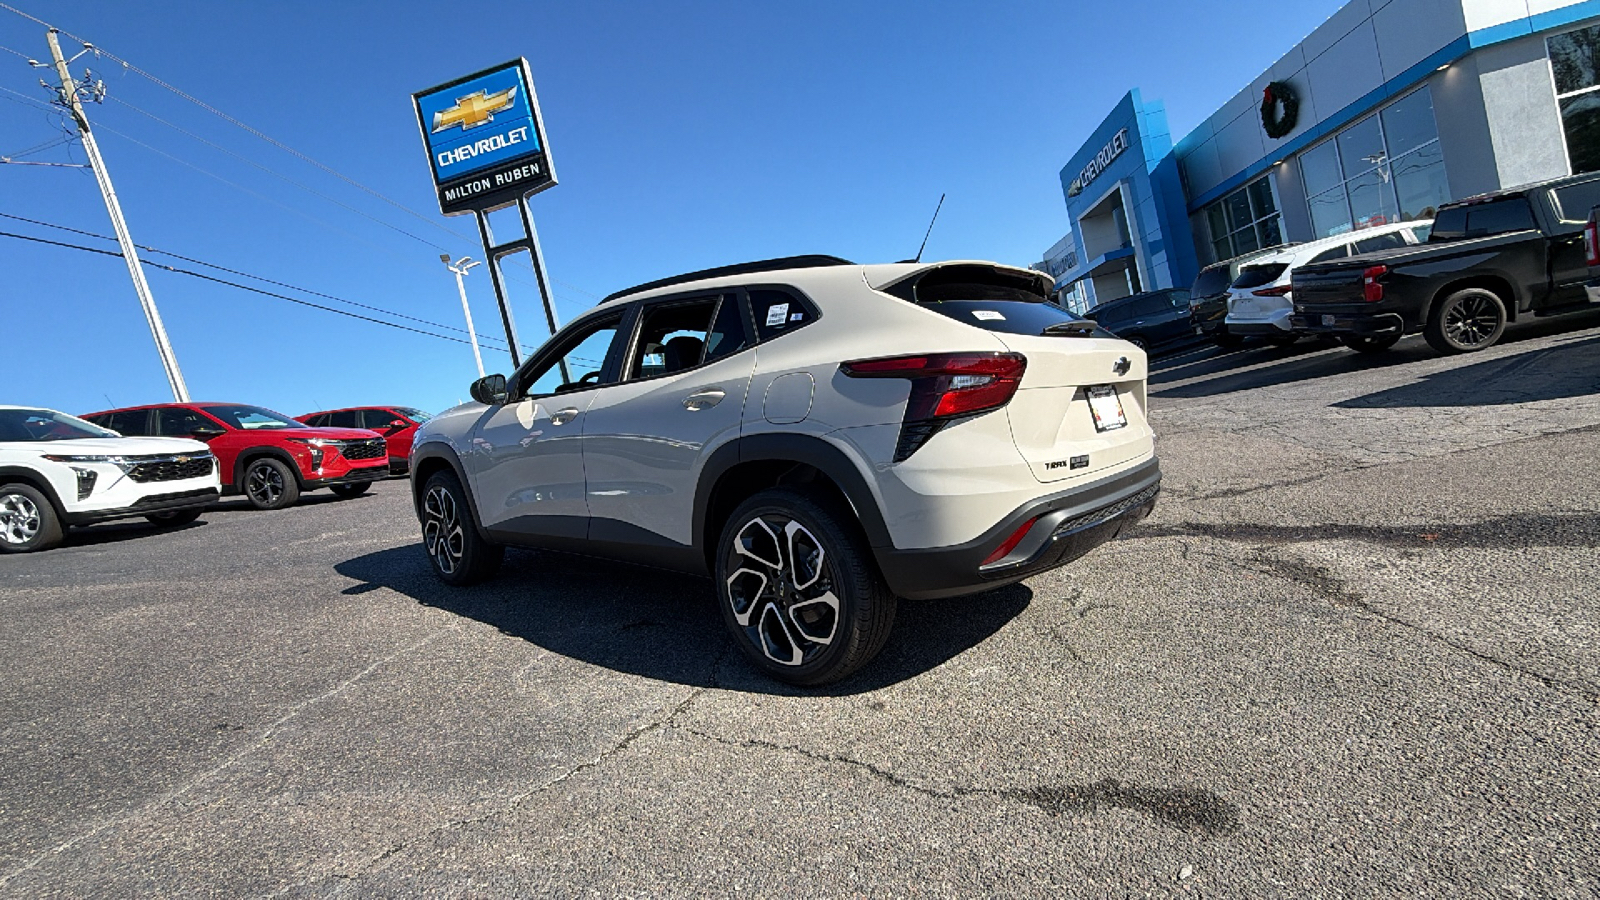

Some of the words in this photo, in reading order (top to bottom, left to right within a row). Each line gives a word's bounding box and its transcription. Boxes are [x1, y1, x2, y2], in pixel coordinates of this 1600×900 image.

[437, 126, 528, 168] CHEVROLET
[1080, 128, 1129, 187] CHEVROLET
[444, 177, 491, 201] MILTON
[495, 162, 540, 186] RUBEN
[1044, 460, 1067, 471] TRAX
